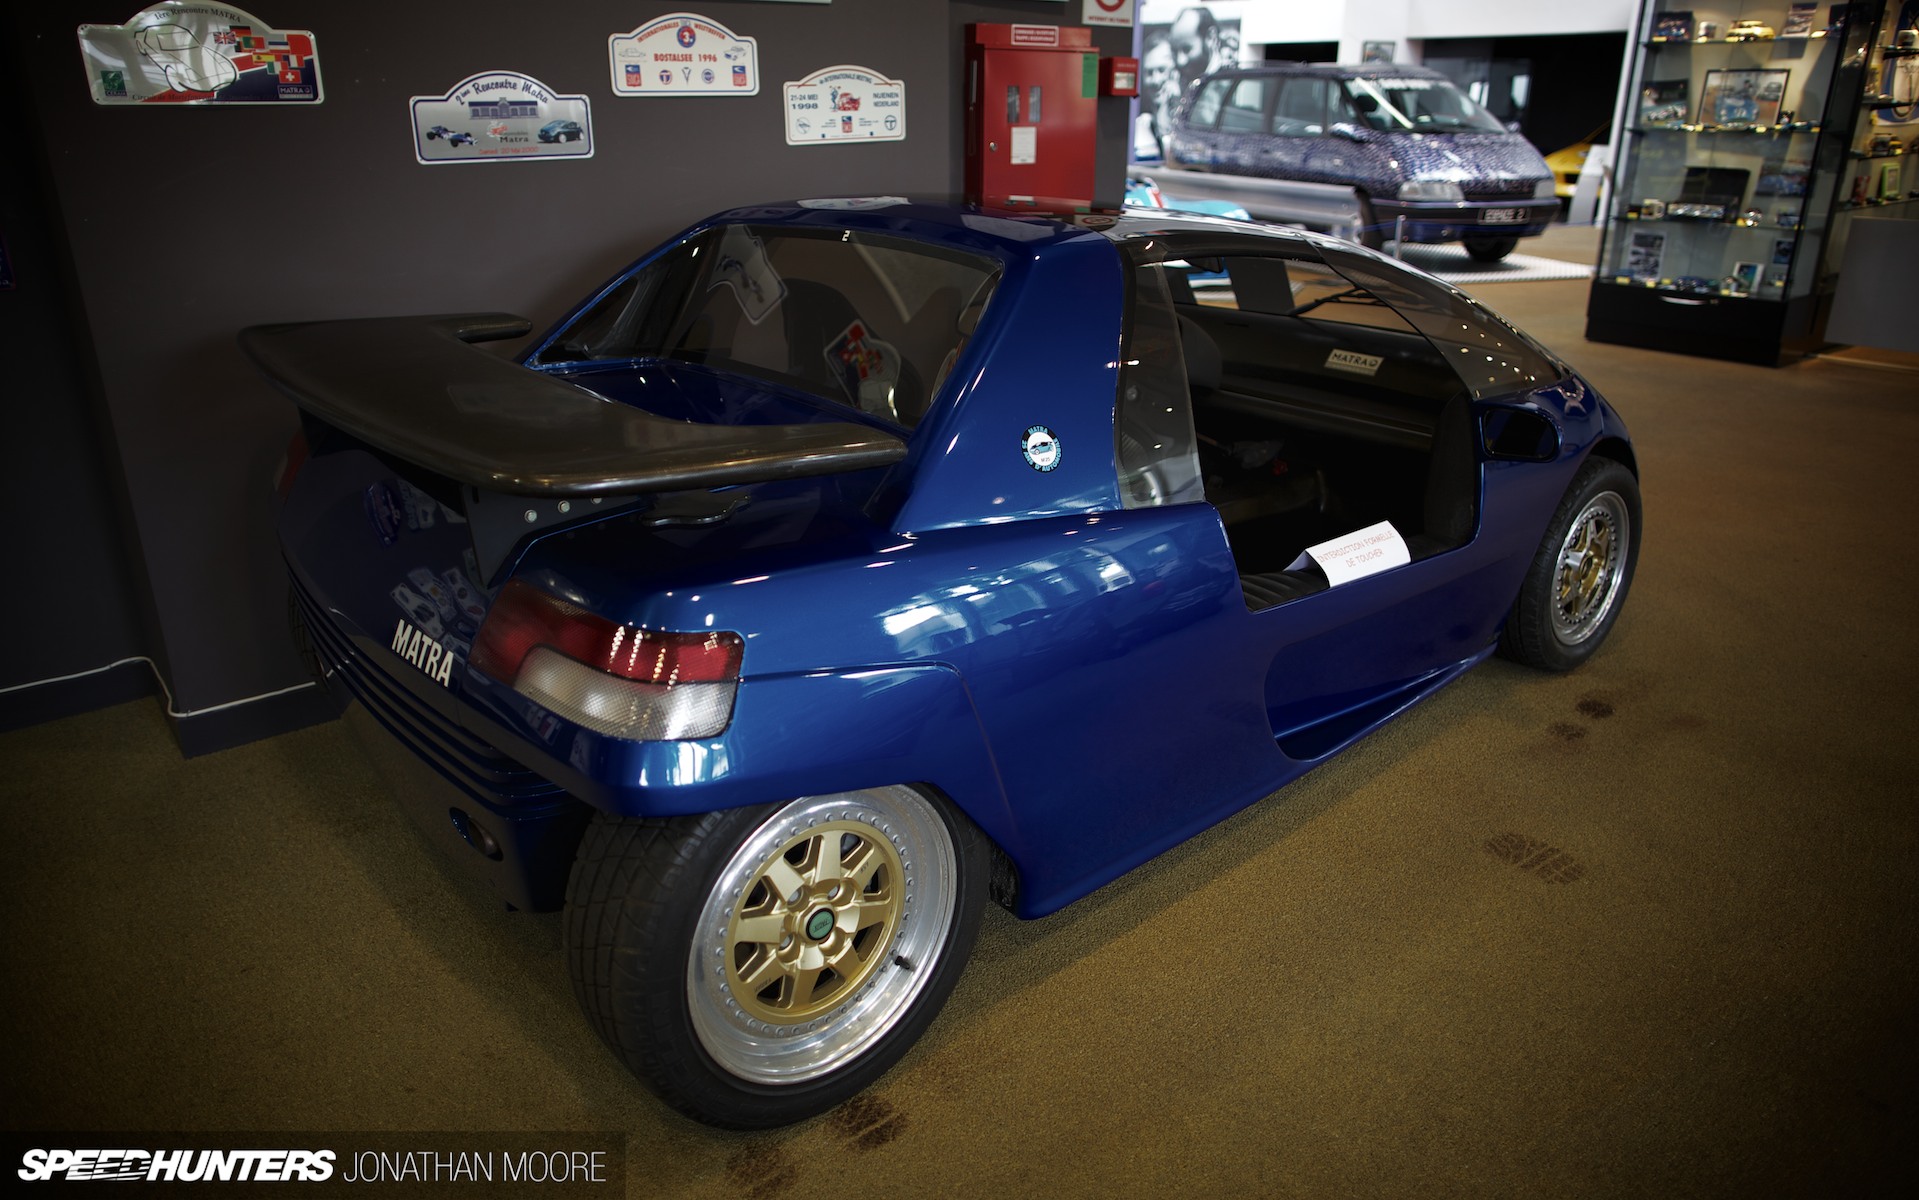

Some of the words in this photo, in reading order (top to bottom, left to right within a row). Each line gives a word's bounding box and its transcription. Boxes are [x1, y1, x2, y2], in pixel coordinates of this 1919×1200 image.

[211, 8, 241, 23] MATRA
[653, 53, 693, 62] BOSTALSEE
[698, 53, 718, 62] 1996
[472, 78, 517, 95] Rencontre
[521, 81, 549, 104] Matra
[1028, 425, 1048, 434] MATRA
[1316, 541, 1365, 563] INTERDICTION
[1363, 530, 1395, 548] FORMELLE
[1345, 557, 1356, 568] DE
[1356, 548, 1384, 563] TOUCHER
[391, 619, 454, 688] MATRA
